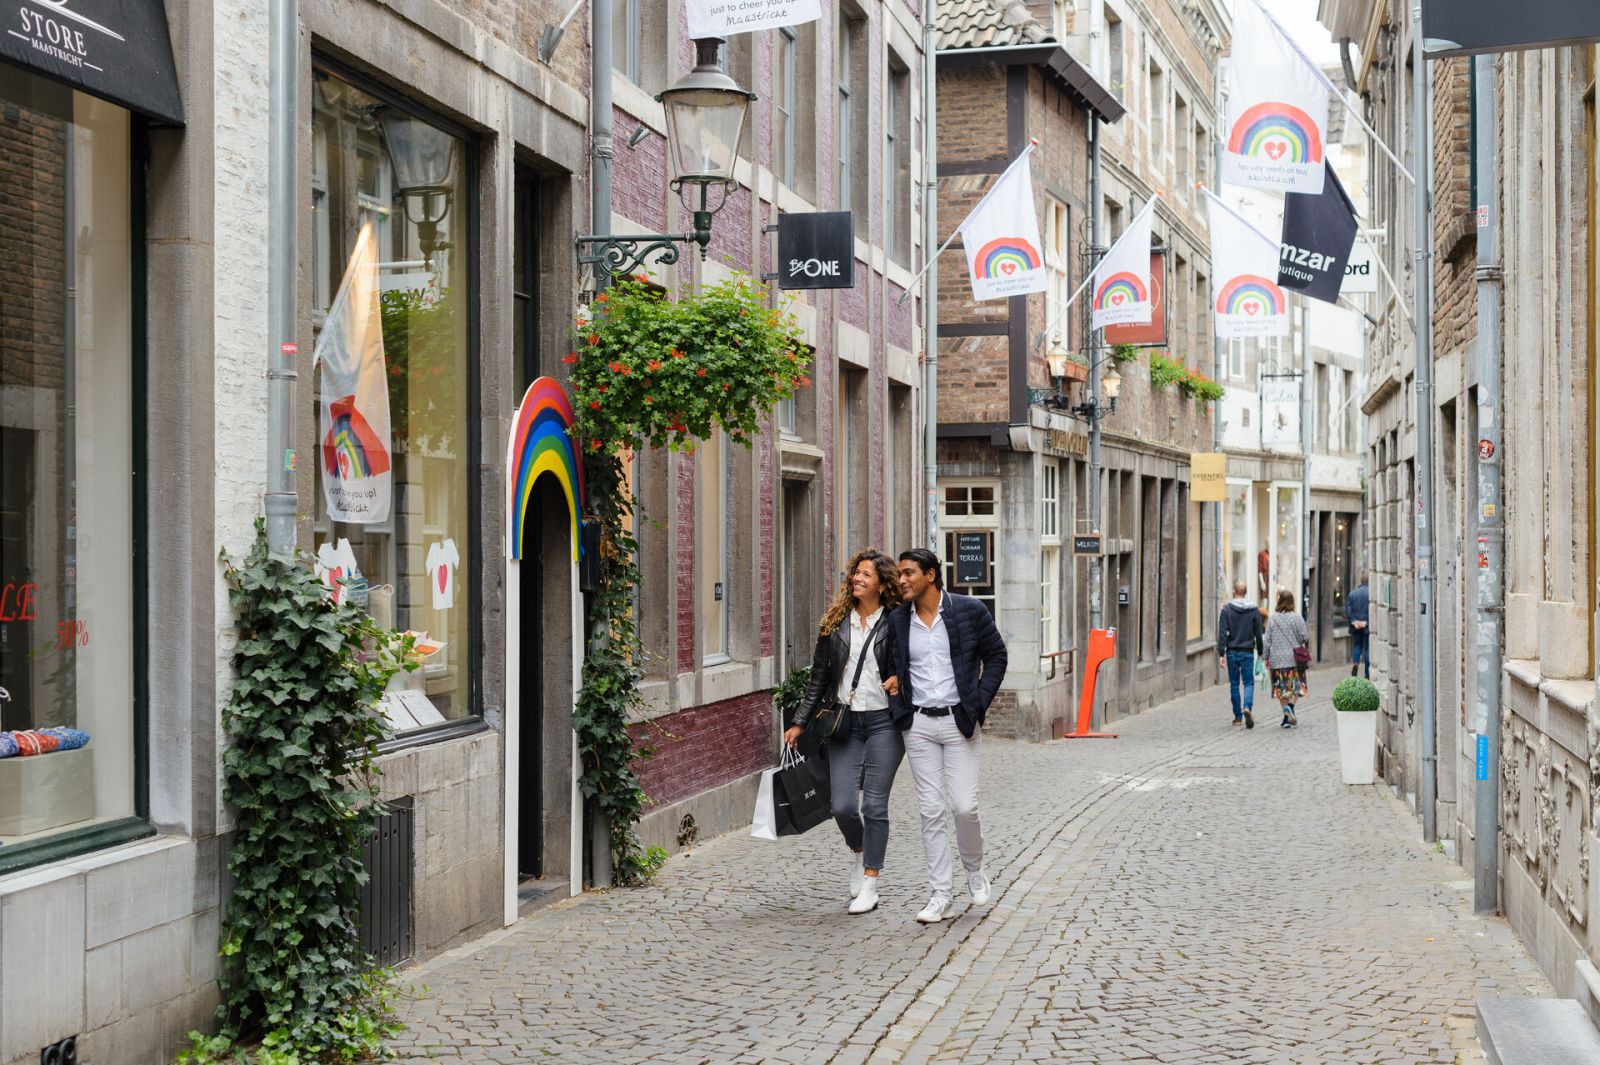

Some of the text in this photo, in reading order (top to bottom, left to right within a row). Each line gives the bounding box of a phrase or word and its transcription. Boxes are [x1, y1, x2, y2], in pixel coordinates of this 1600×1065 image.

[710, 5, 725, 17] just
[727, 4, 737, 12] to
[738, 0, 764, 10] cheer
[20, 7, 87, 57] STORE
[31, 37, 83, 68] MAASTRICHT
[364, 487, 377, 499] up!
[959, 554, 984, 562] TERRAS
[53, 619, 90, 650] 50%
